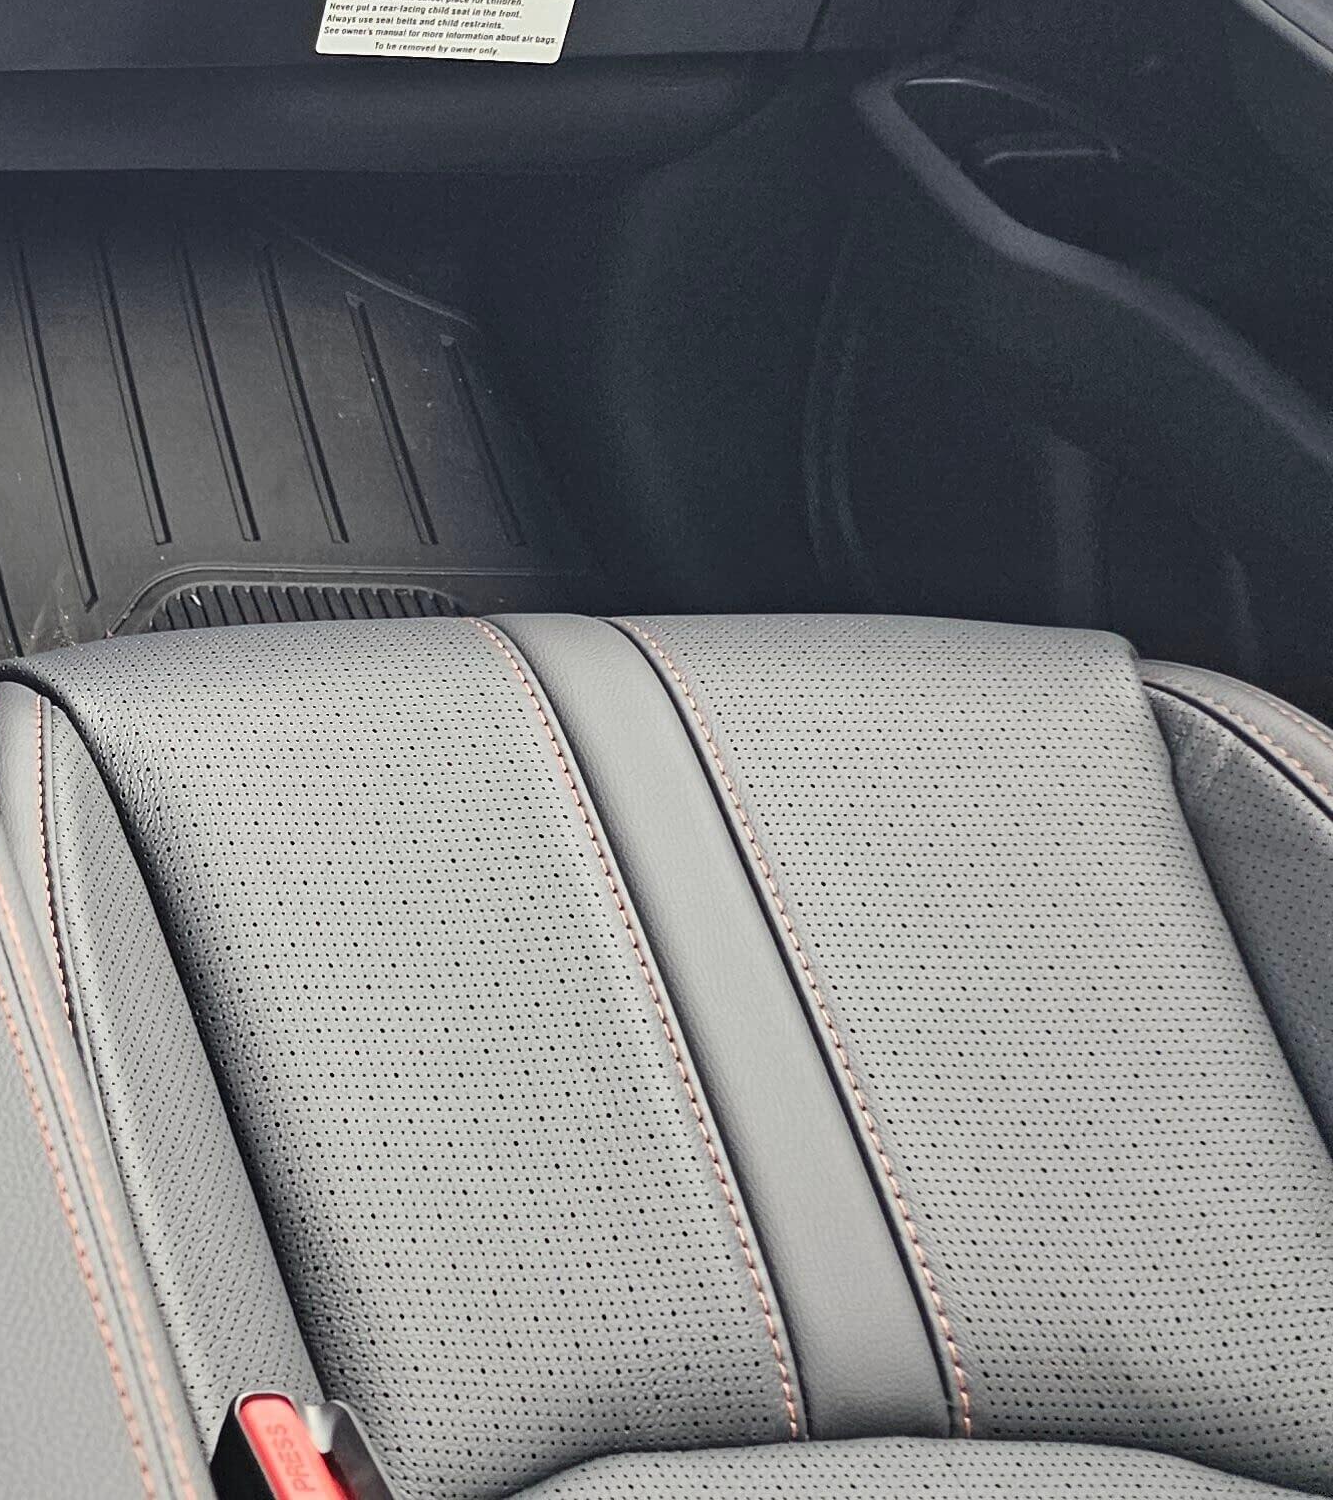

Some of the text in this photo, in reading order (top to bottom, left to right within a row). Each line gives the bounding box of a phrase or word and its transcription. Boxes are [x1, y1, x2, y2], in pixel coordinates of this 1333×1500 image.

[329, 3, 354, 11] Never
[356, 4, 369, 13] put
[428, 6, 449, 15] child
[451, 7, 470, 16] seat
[472, 8, 481, 16] in
[483, 9, 496, 17] the
[266, 1424, 316, 1492] PRESS
